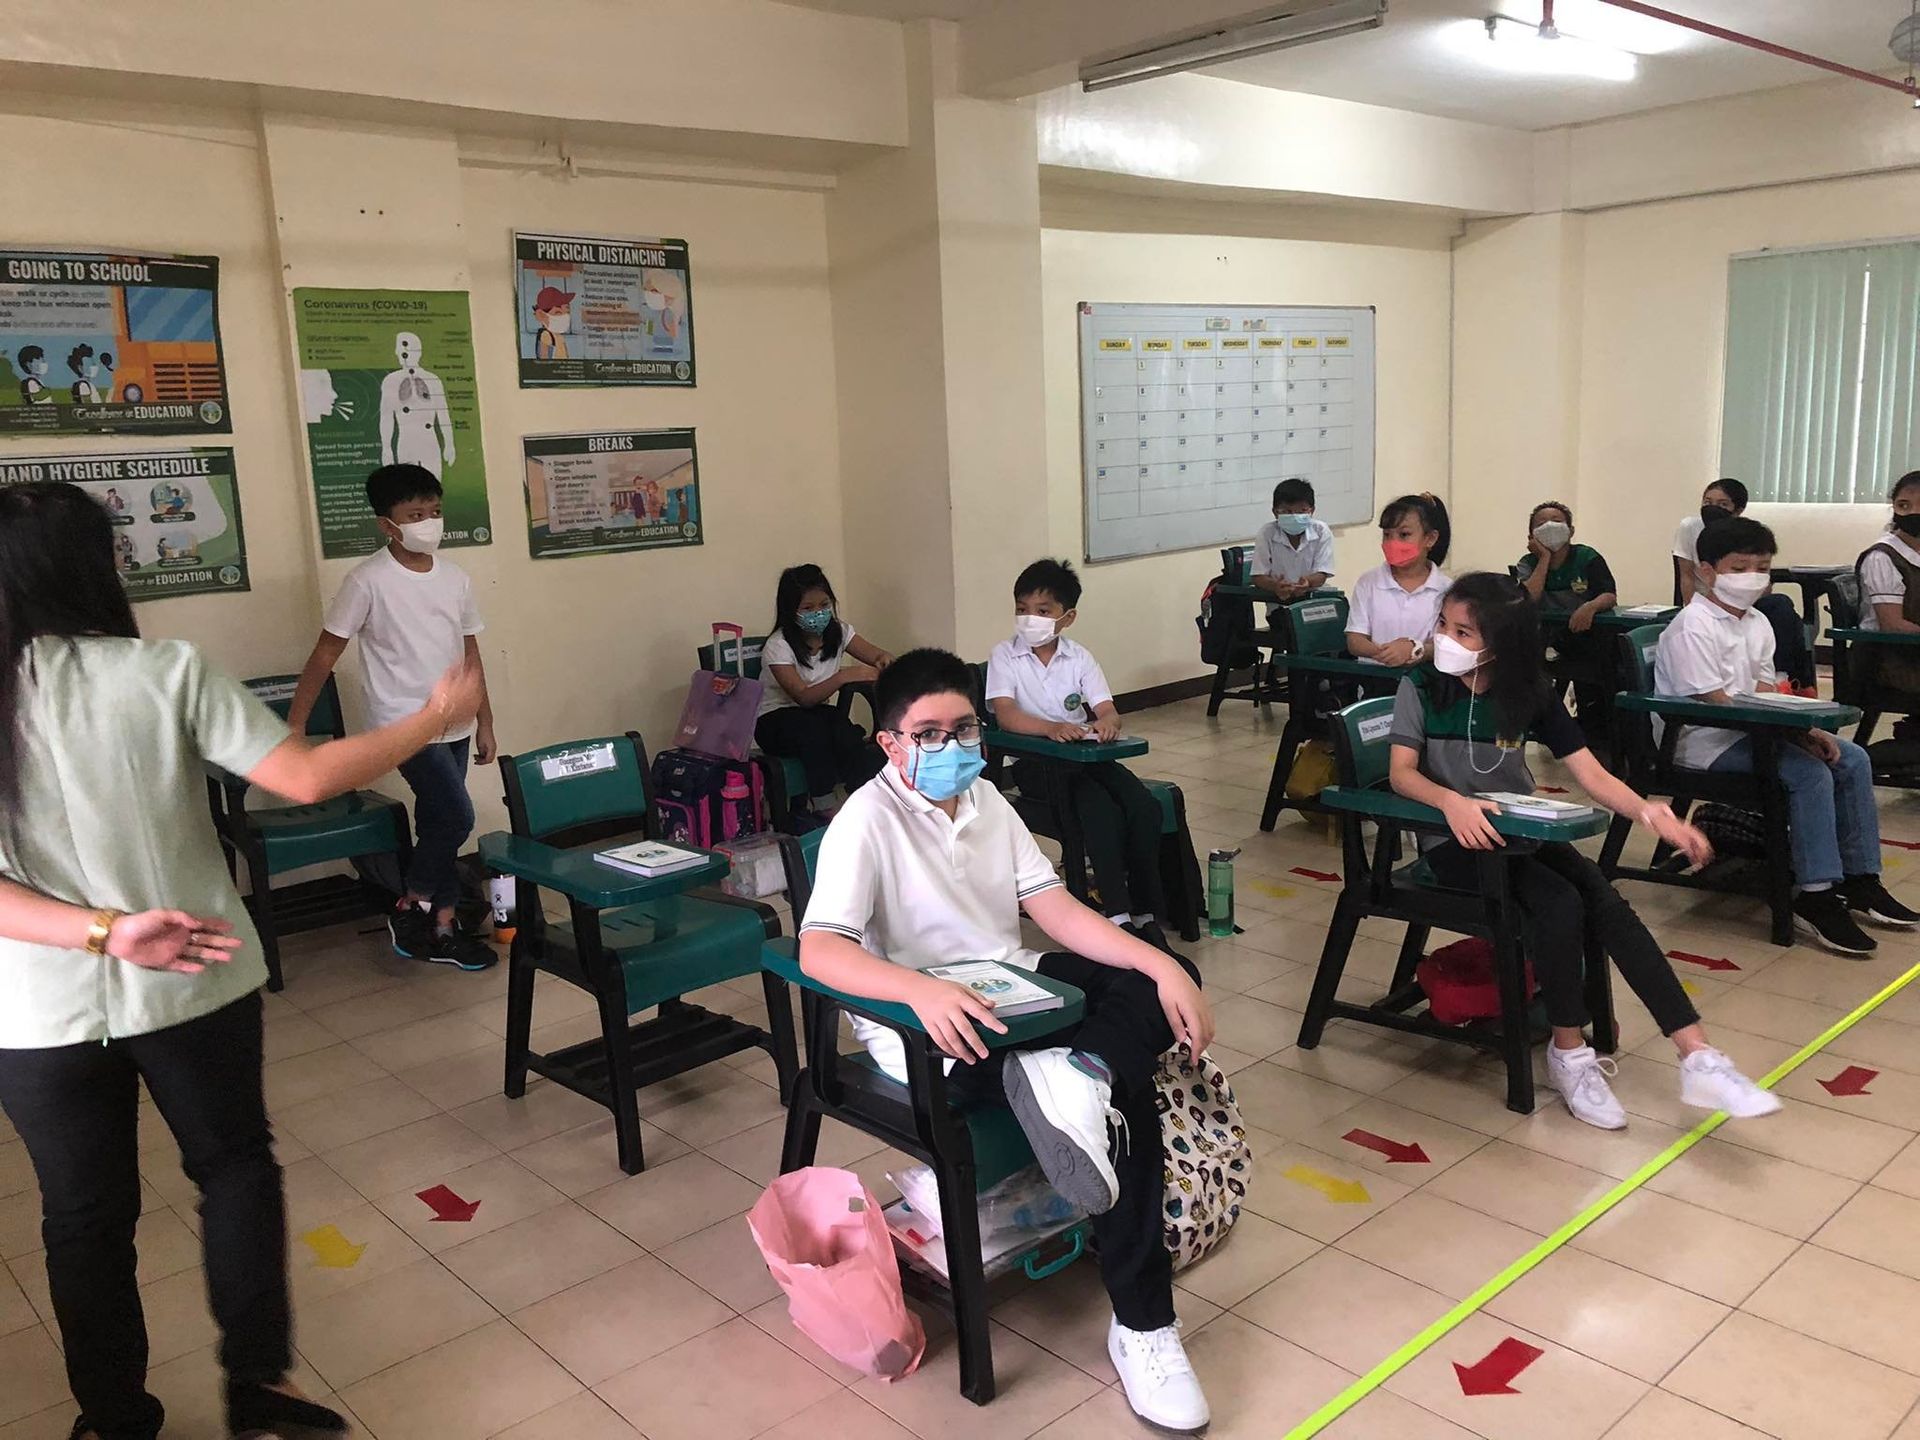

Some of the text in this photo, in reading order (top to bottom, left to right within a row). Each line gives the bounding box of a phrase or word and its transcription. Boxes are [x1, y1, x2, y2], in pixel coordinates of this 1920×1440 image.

[537, 242, 666, 267] PHYSICAL DISTANCING
[8, 260, 152, 282] GOING TO SCHOOL
[304, 299, 428, 311] Coronavirus (COVID-19)
[633, 363, 672, 374] EDUCATION
[134, 406, 193, 419] EDUCATION
[588, 437, 633, 452] BREAKS
[49, 460, 123, 481] HYGIENE
[127, 458, 210, 478] SCHEDULE
[442, 530, 469, 540] CATION
[641, 526, 679, 537] EDUCATION
[155, 570, 213, 585] EDUCATION
